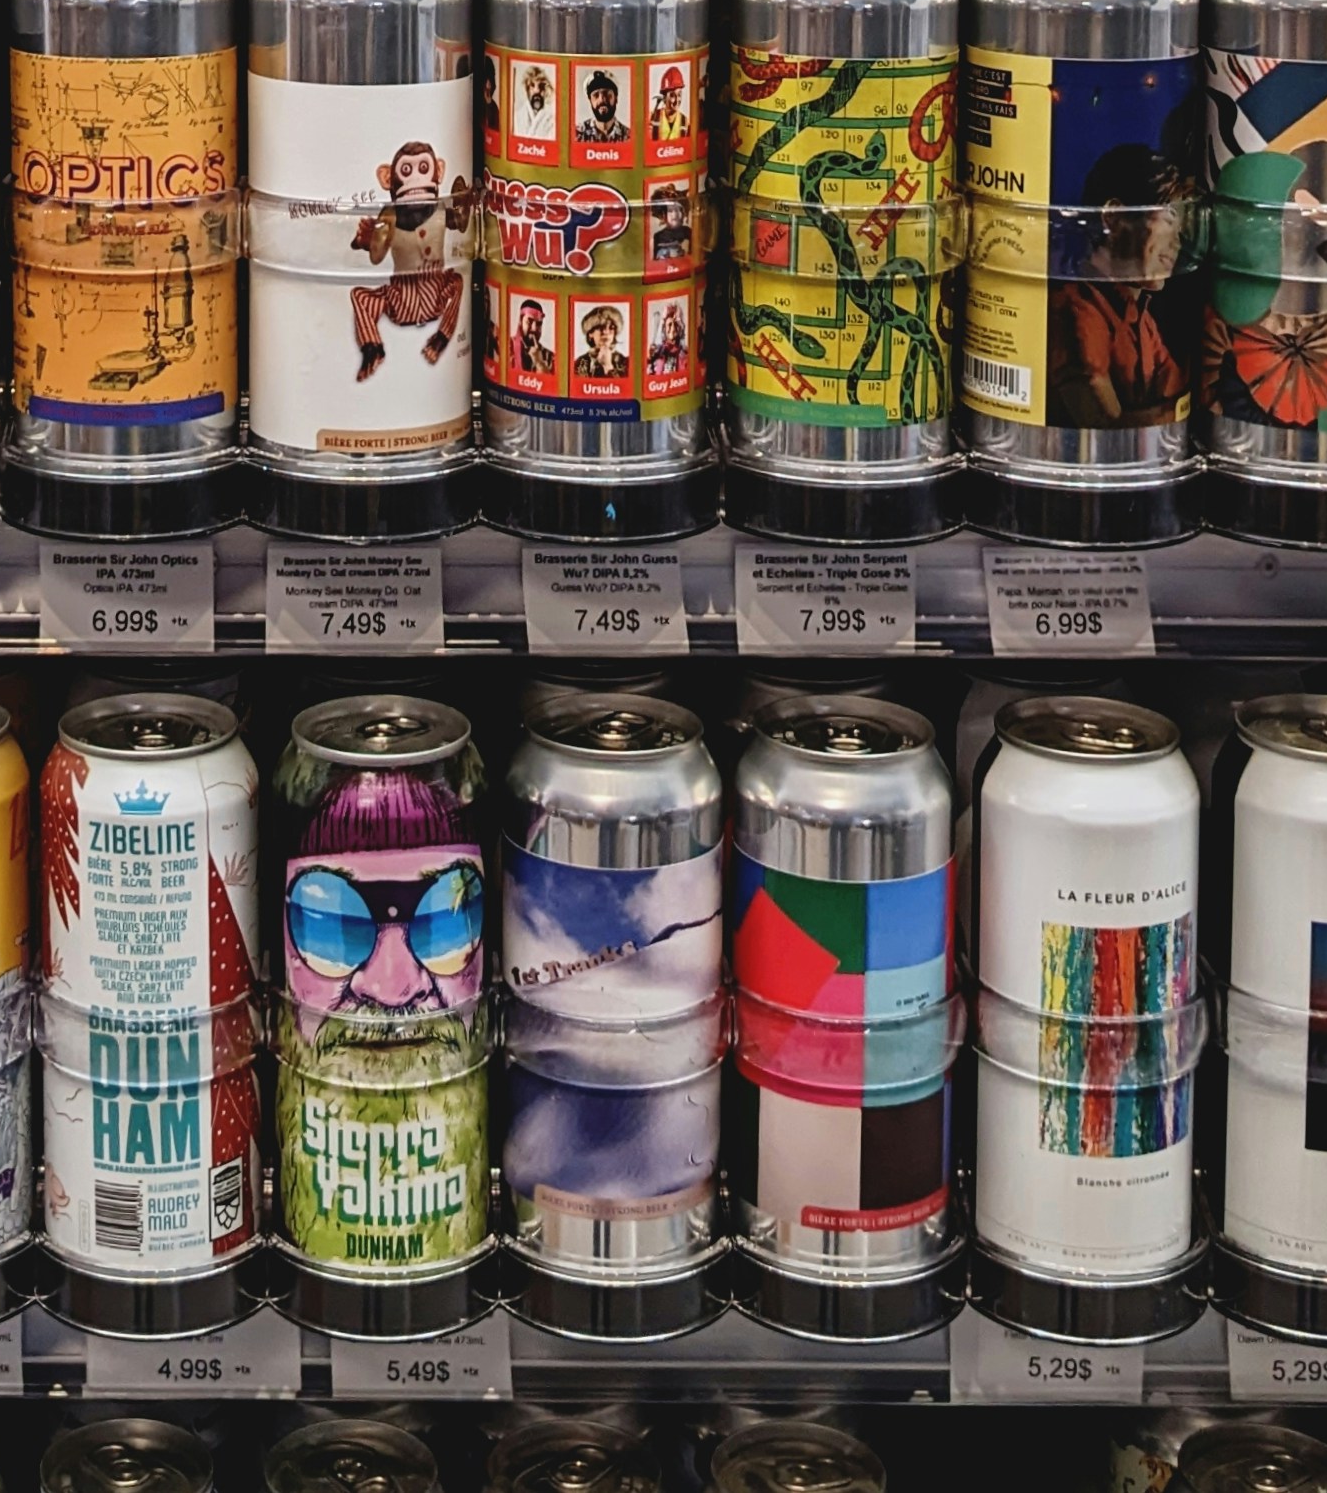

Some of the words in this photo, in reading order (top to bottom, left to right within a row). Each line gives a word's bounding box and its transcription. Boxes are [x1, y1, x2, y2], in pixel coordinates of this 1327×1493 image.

[518, 143, 546, 158] Zaché
[586, 148, 620, 161] Denis
[656, 144, 684, 158] Céline
[22, 151, 225, 207] OPTICS
[518, 376, 543, 392] Eddy
[582, 382, 621, 395] Ursula
[648, 380, 668, 394] Guy
[670, 376, 687, 390] Jean
[129, 554, 158, 565] John
[92, 610, 158, 634] 6,99$
[320, 612, 386, 636] 7,49$
[799, 610, 867, 633] 7,99$
[89, 821, 195, 855] ZIBELINE
[161, 857, 198, 873] STRONG
[1057, 889, 1079, 901] LA
[1084, 891, 1135, 905] FLEUR
[1141, 882, 1187, 903] D'ALICE
[90, 1032, 200, 1102] DUN
[93, 1097, 200, 1165] HAM
[302, 1096, 446, 1167] Sierra
[313, 1151, 467, 1229] Yakima
[148, 1193, 200, 1214] AUDREY
[148, 1213, 187, 1231] MALO
[346, 1233, 423, 1260] DUNHAM
[158, 1359, 222, 1382] 4,99$
[386, 1360, 450, 1383] 5,49$
[1028, 1357, 1092, 1381] 5,29$
